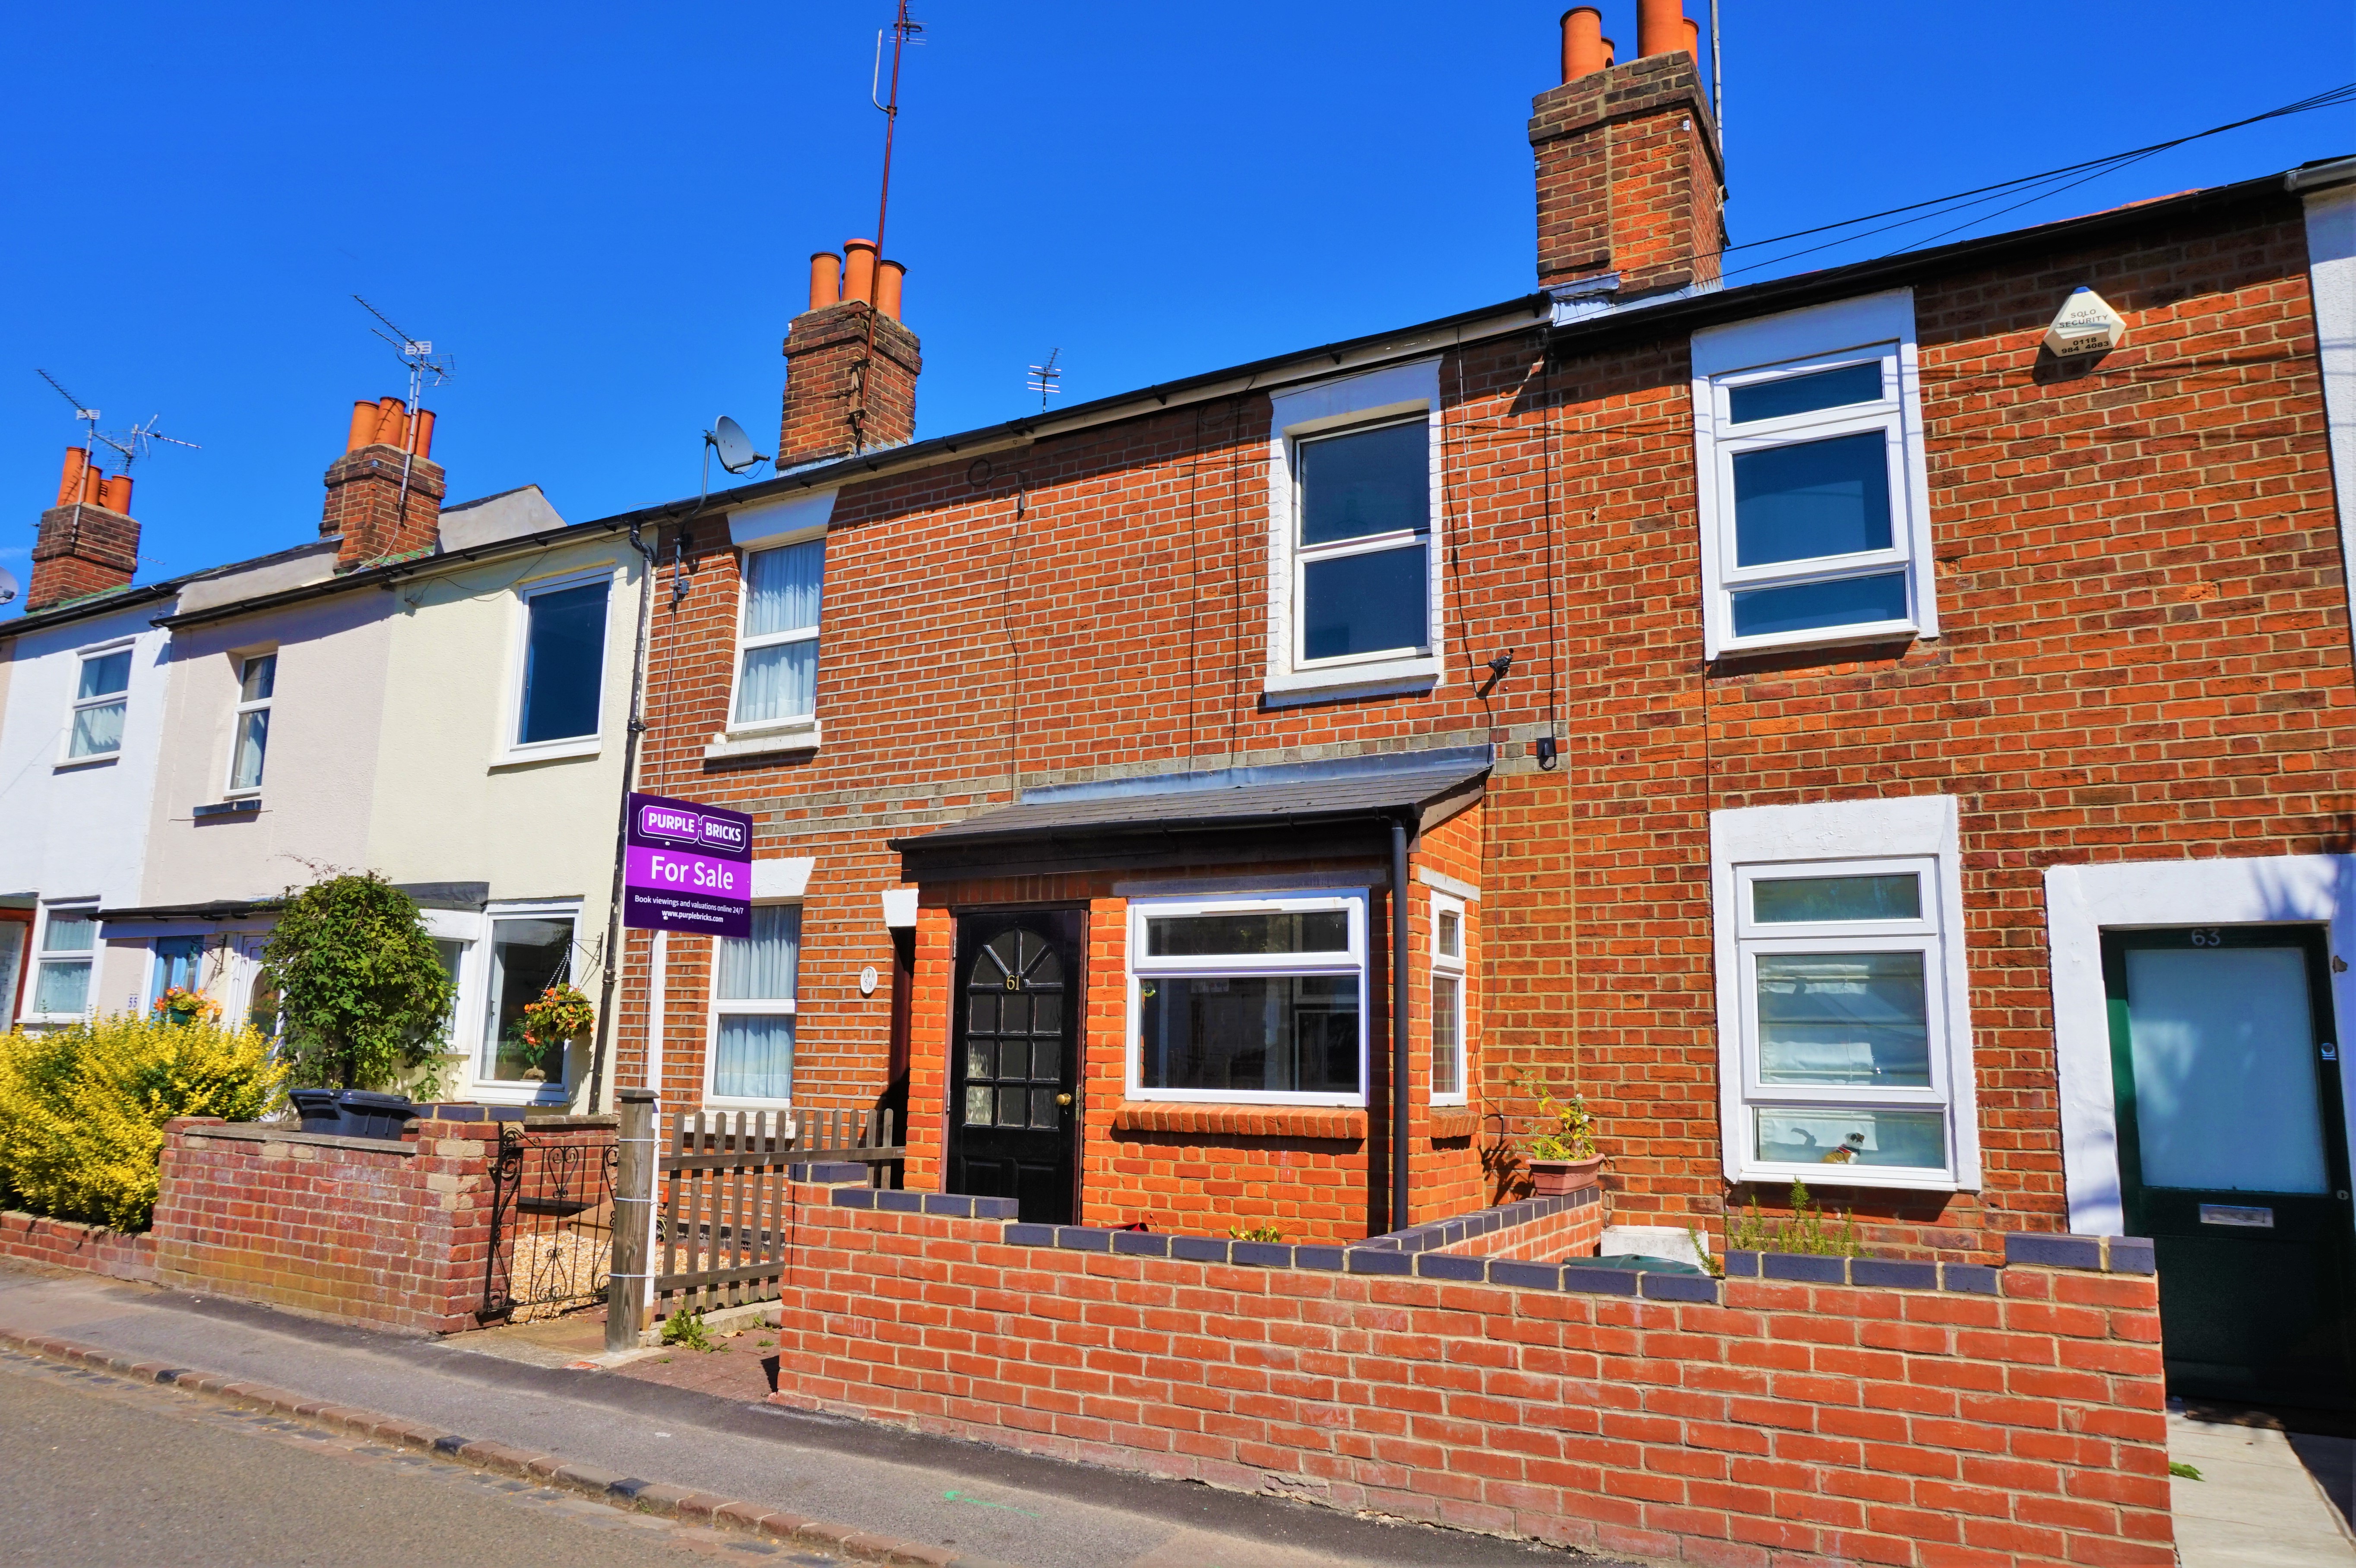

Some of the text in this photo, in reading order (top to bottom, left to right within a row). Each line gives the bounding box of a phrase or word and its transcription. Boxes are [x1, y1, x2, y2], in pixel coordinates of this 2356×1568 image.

[2071, 309, 2096, 318] SOLO
[2059, 314, 2108, 328] SECURITY
[2062, 341, 2109, 354] 984 4083
[2073, 337, 2097, 346] 0118
[648, 812, 741, 842] PURPLE BRICKS
[651, 855, 734, 890] For Sale
[635, 895, 652, 904] Book
[652, 897, 679, 907] viewings
[691, 901, 717, 911] valuations
[732, 907, 744, 915] 24/7
[662, 910, 724, 923] www.purplebricks.com
[2191, 928, 2220, 946] 63
[864, 979, 872, 989] 59
[1006, 975, 1020, 990] 61
[128, 997, 138, 1008] 55
